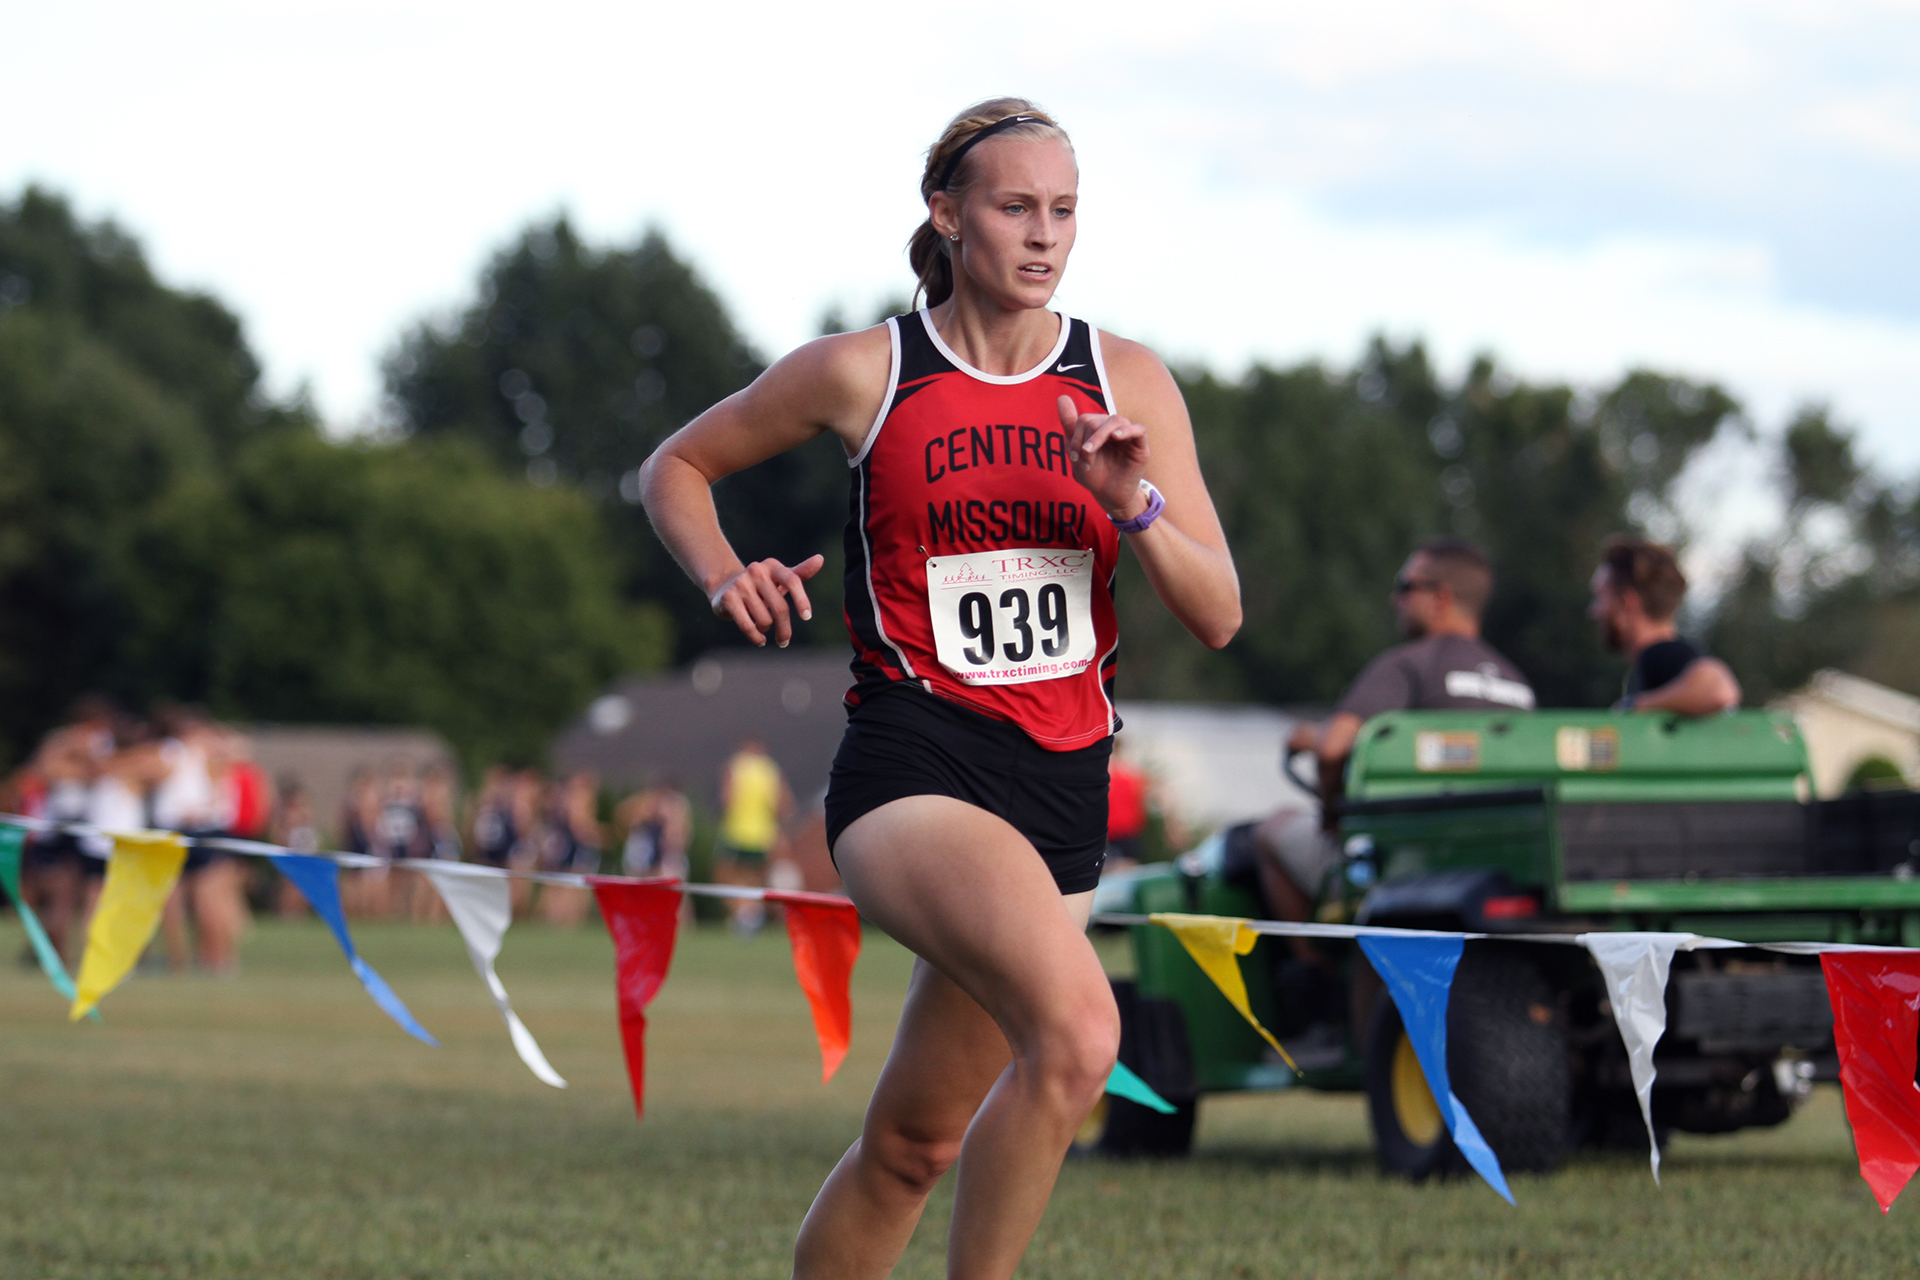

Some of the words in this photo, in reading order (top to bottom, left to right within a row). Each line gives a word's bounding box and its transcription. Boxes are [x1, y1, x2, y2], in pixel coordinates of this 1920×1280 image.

[925, 424, 1068, 484] CENTRA
[927, 500, 1086, 545] MISSOURI
[991, 555, 1084, 573] TRXC
[999, 570, 1052, 580] TIMING,
[958, 583, 1070, 666] 939
[953, 658, 1088, 680] www.trxctiming.com
